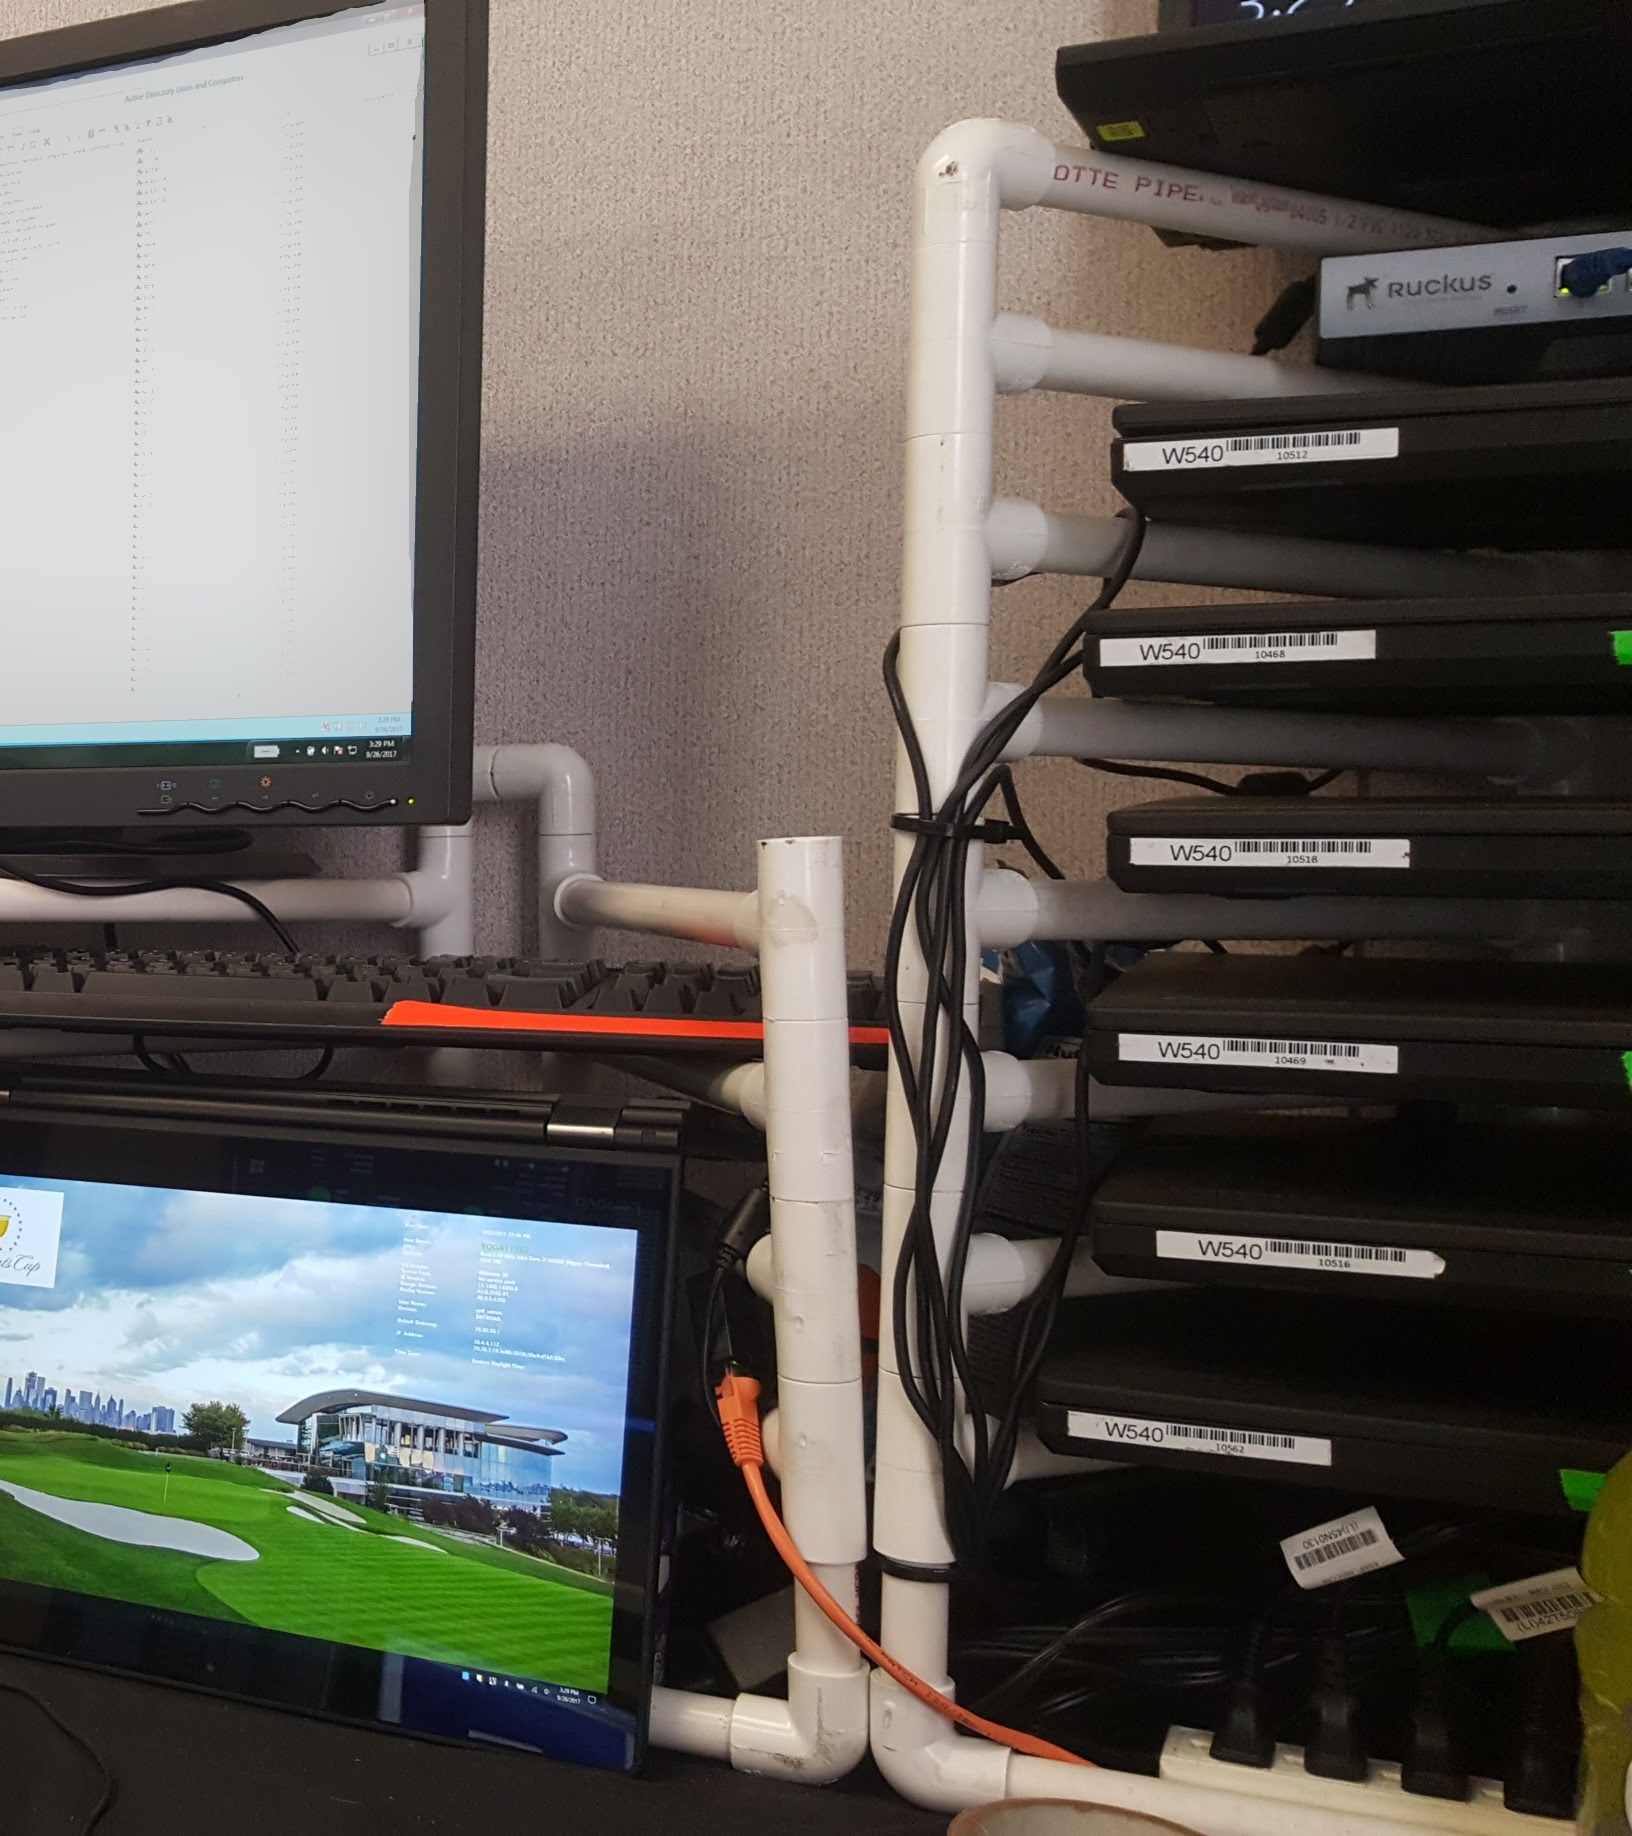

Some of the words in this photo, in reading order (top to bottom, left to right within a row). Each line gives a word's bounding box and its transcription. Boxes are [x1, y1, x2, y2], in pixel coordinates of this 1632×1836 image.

[1135, 175, 1197, 202] PIPE
[1162, 444, 1224, 464] W540
[1277, 450, 1308, 461] 10512
[1139, 643, 1200, 661] W540
[1255, 650, 1285, 660] 10468
[369, 740, 382, 748] 3:29
[365, 750, 397, 759] 9/26/2017
[1170, 844, 1232, 862] W540
[1287, 855, 1318, 864] 10518
[1158, 1040, 1220, 1060] W540
[1275, 1056, 1307, 1066] 10469
[1198, 1240, 1263, 1260] W540
[1318, 1258, 1351, 1269] 10516
[12, 1254, 41, 1277] Cup
[1105, 1421, 1164, 1443] W540
[1215, 1443, 1245, 1454] 10562
[556, 1694, 581, 1705] 9/26/2017
[570, 1688, 580, 1696] PM
